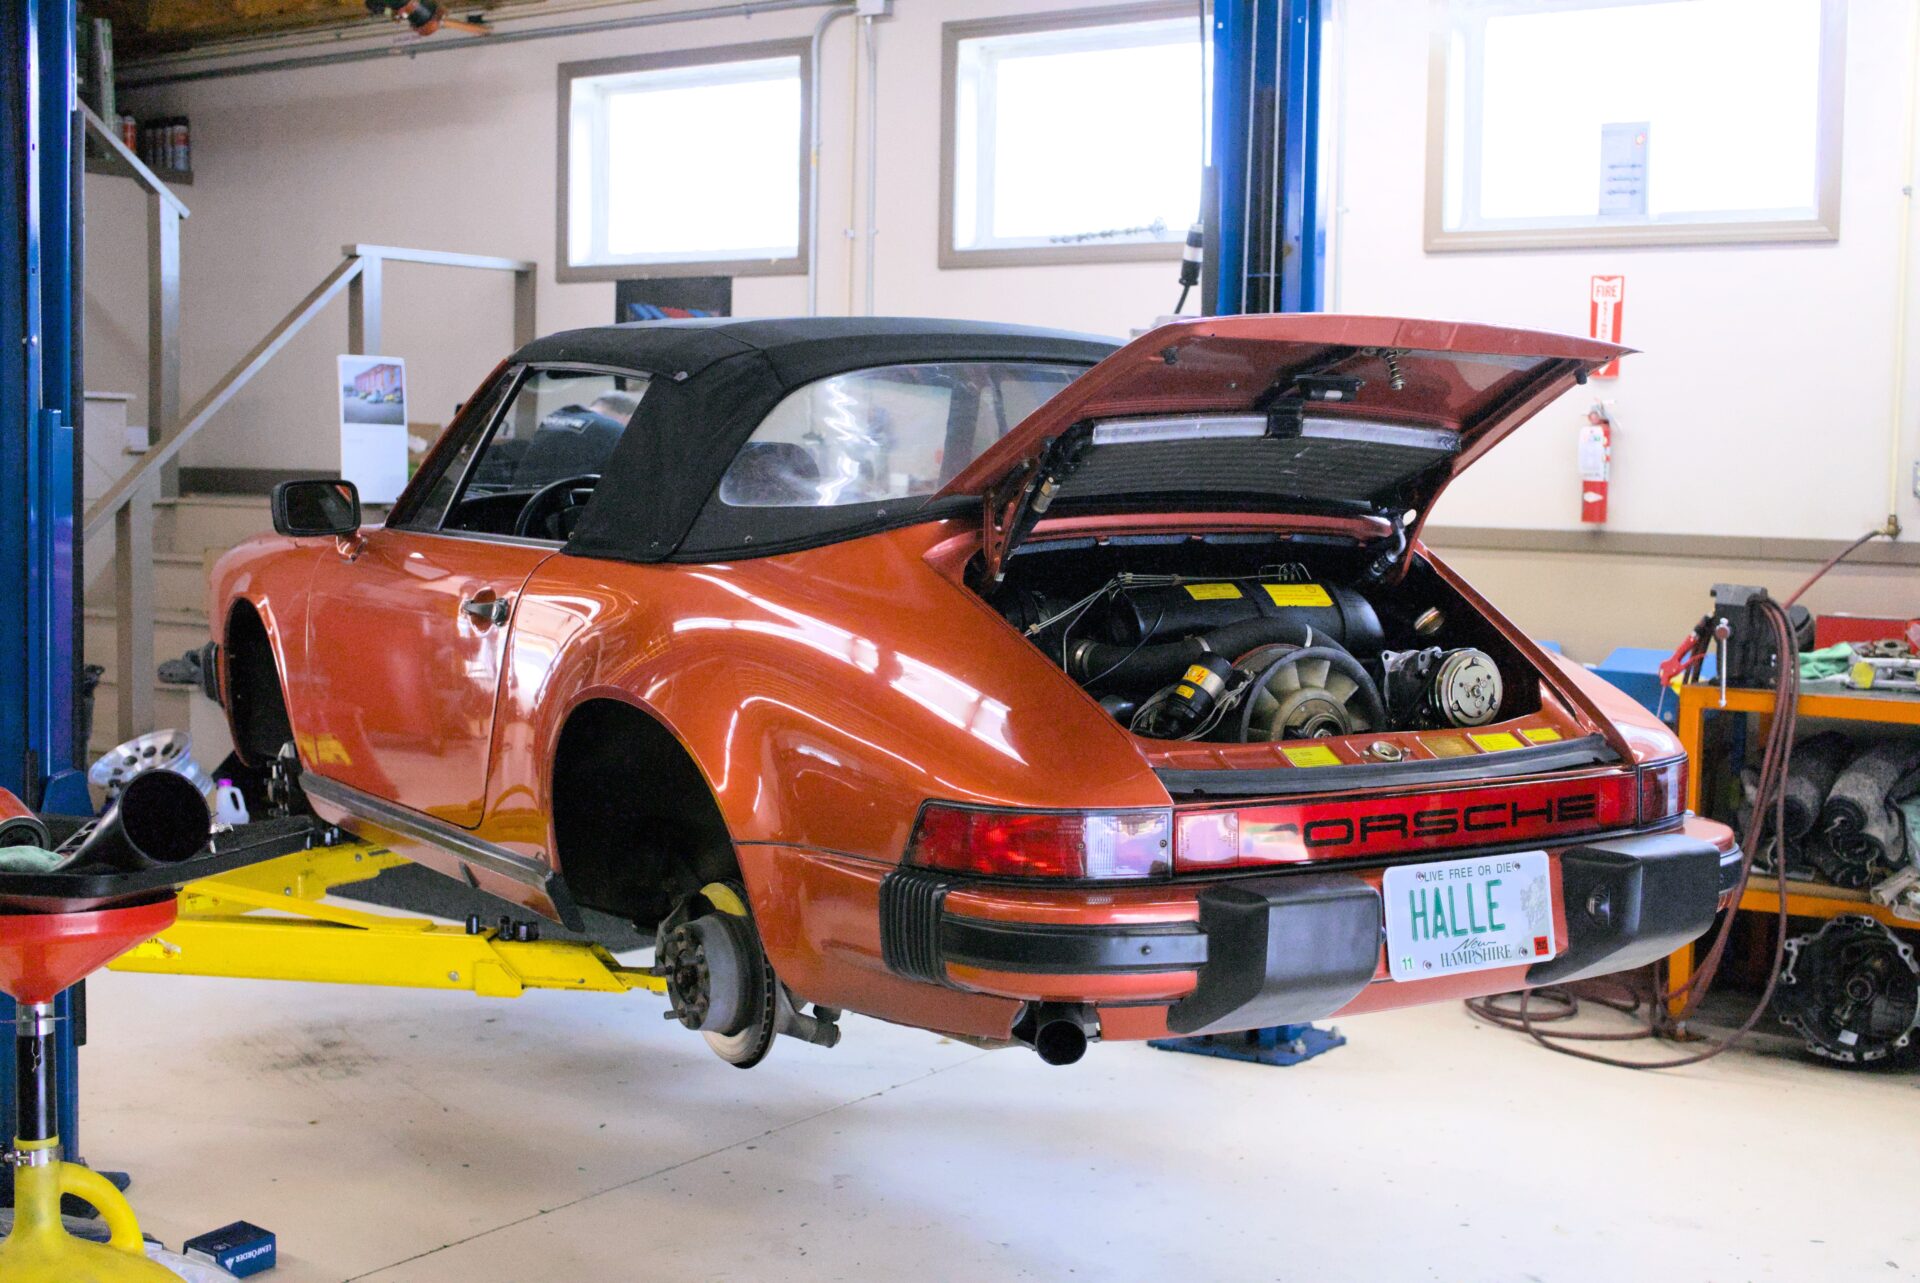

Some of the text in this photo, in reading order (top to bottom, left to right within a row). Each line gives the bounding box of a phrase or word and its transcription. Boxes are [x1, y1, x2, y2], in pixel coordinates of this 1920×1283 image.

[1596, 285, 1617, 297] FIRE
[1424, 862, 1512, 882] LIVE FREE OR DIE
[1409, 879, 1506, 942] HALLE
[1453, 937, 1496, 952] New
[1402, 957, 1413, 970] 11
[1440, 944, 1512, 968] HAMPSHIRE
